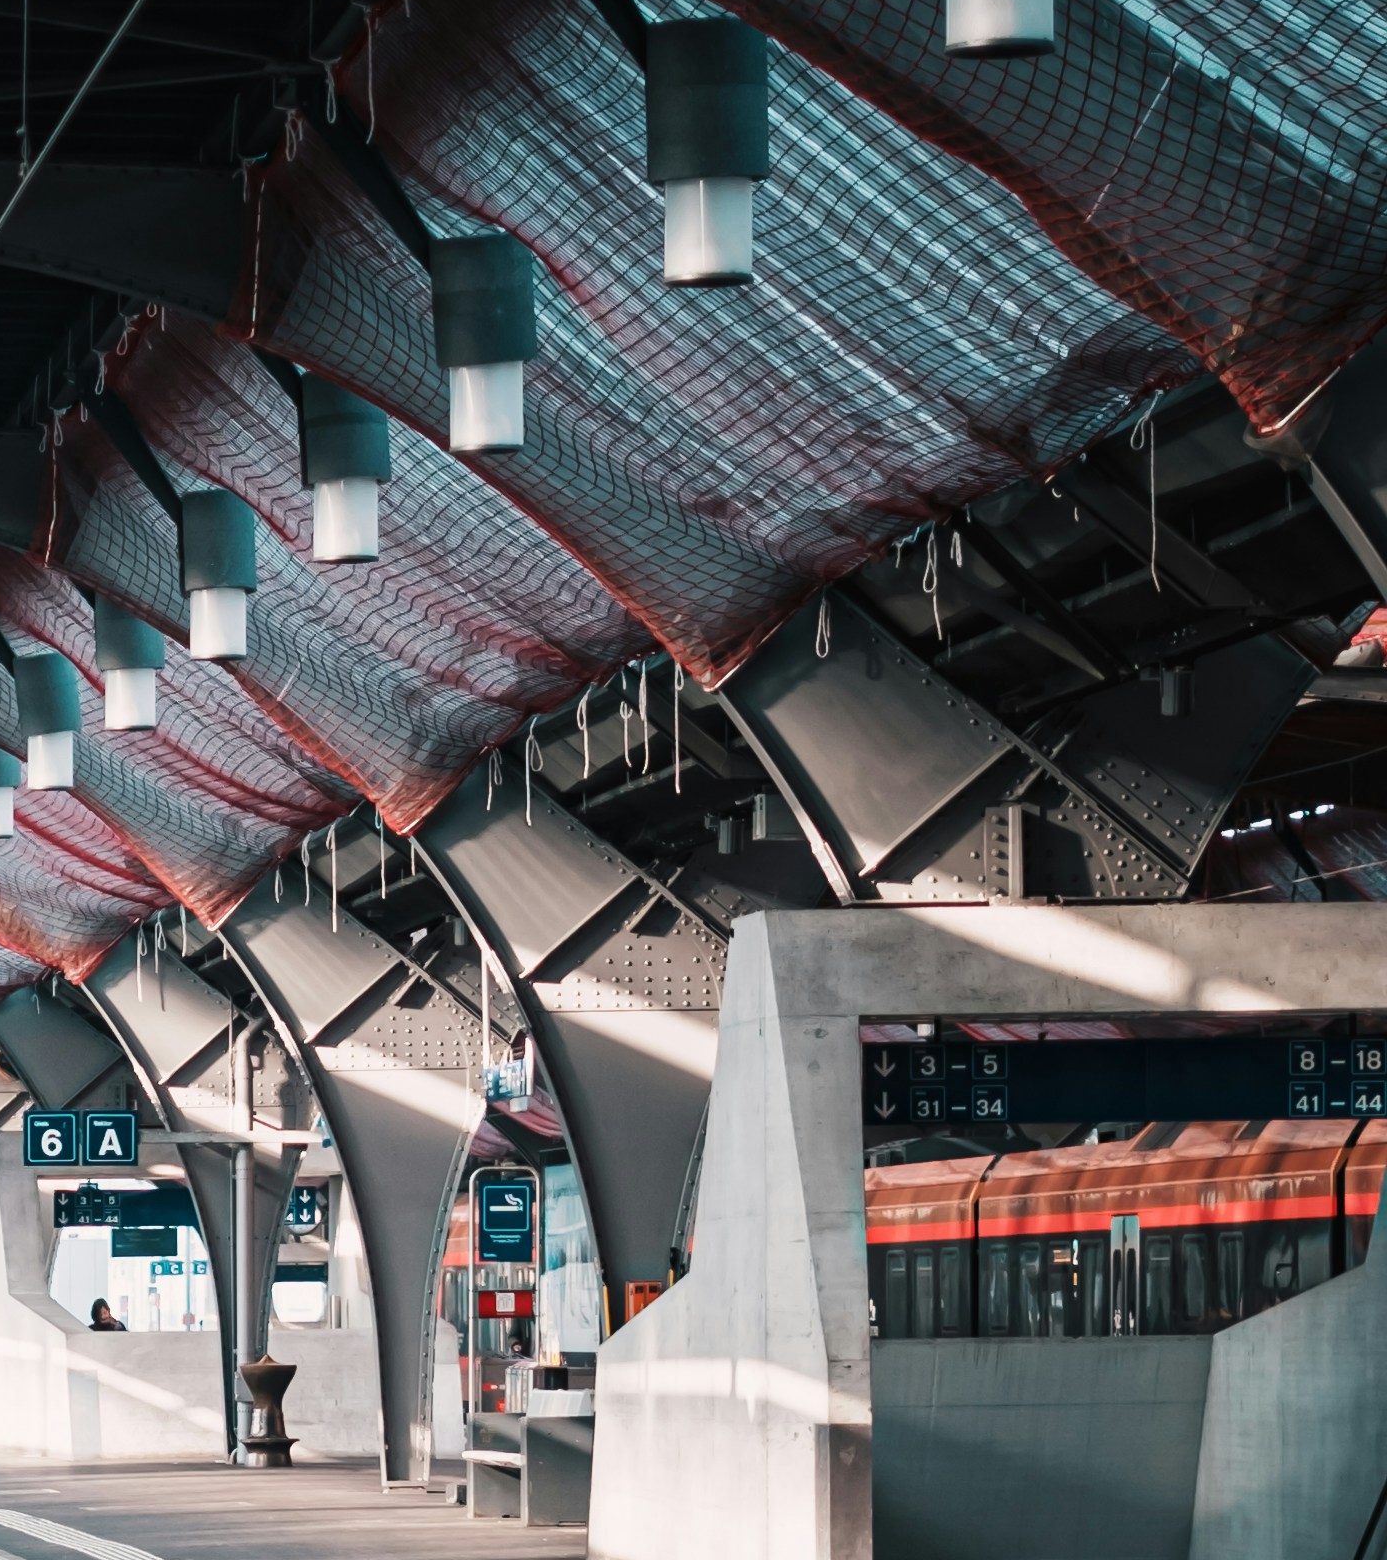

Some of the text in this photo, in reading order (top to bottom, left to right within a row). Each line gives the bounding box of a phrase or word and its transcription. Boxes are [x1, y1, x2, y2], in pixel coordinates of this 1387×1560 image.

[920, 1056, 936, 1075] 3
[983, 1054, 998, 1075] 5
[1300, 1051, 1315, 1071] 8
[1356, 1050, 1382, 1070] 18
[917, 1100, 939, 1117] 31
[976, 1099, 1003, 1116] 34
[1296, 1095, 1319, 1113] 41
[1355, 1094, 1382, 1112] 44
[41, 1128, 123, 1157] 6 A
[80, 1196, 87, 1205] 3
